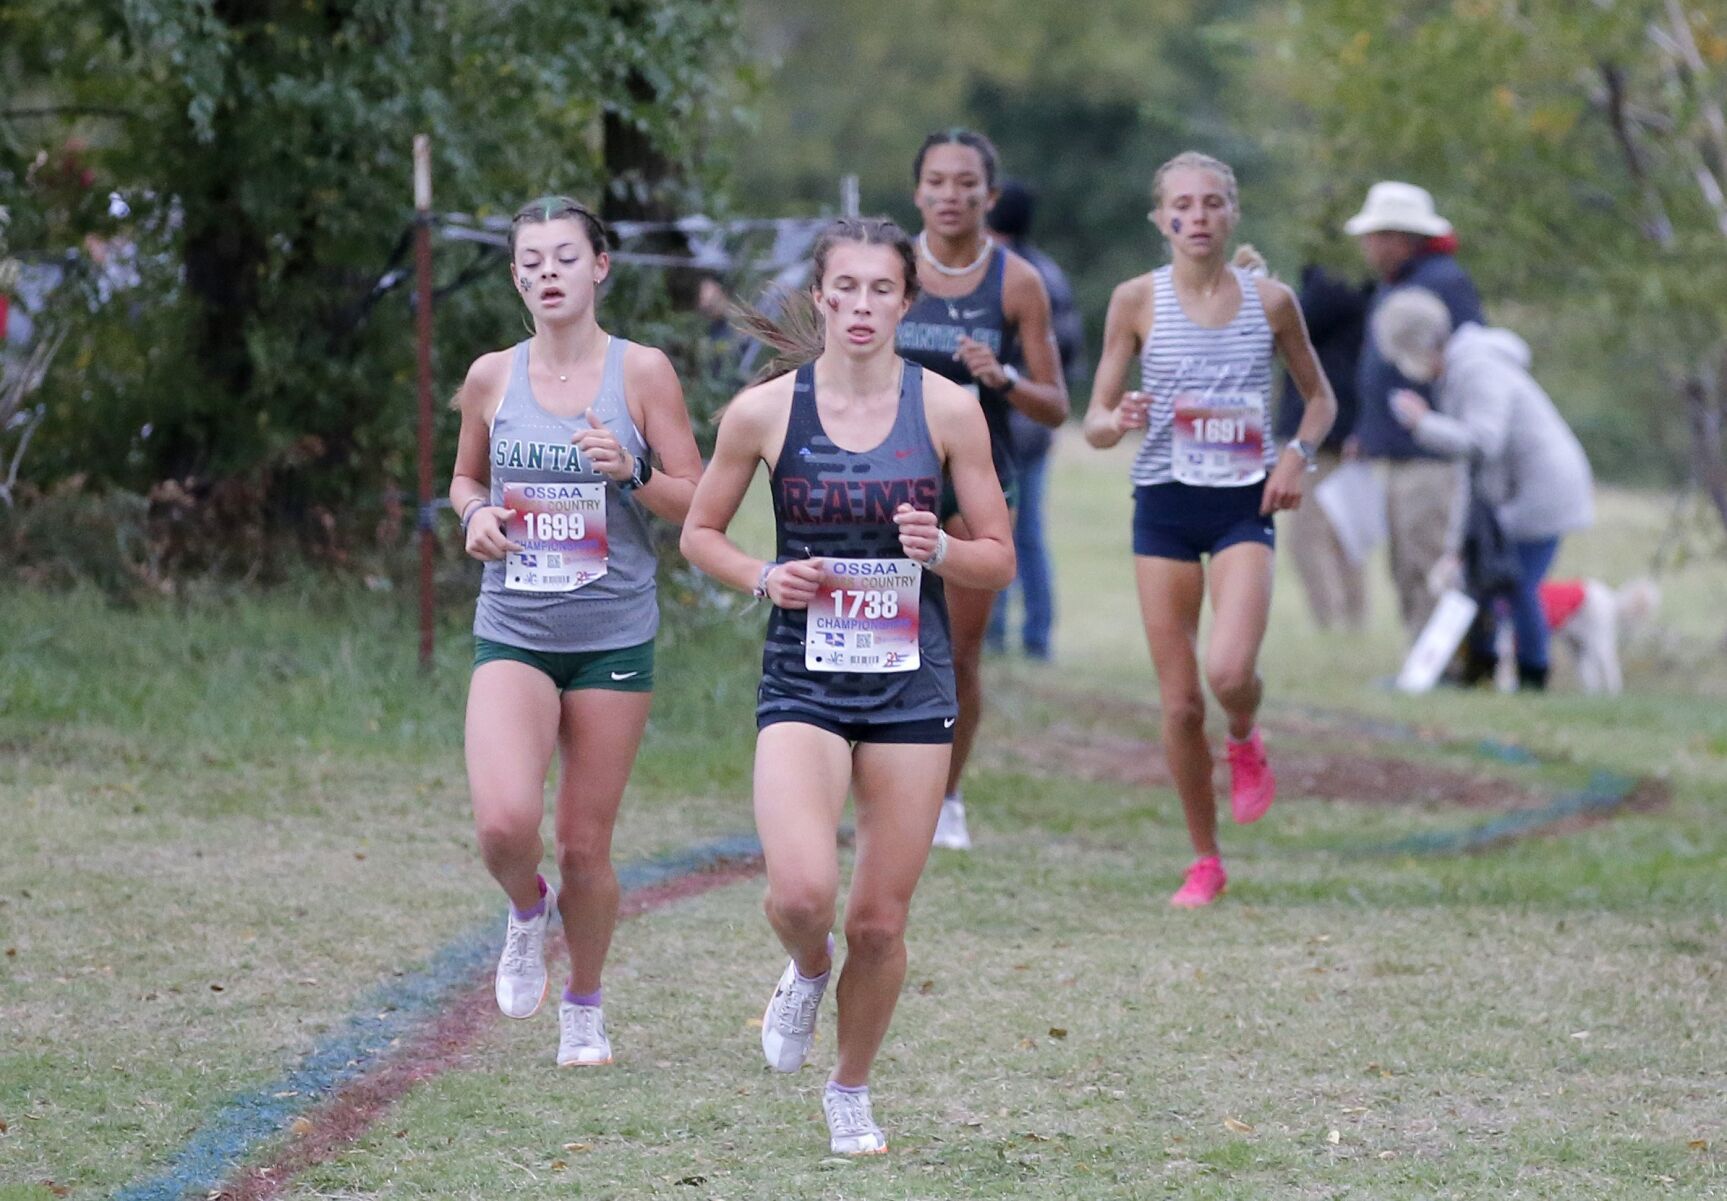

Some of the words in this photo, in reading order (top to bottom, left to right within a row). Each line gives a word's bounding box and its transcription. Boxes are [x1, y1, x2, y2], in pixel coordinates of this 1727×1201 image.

[1191, 418, 1247, 443] 1691
[496, 440, 582, 473] SANTA
[524, 486, 583, 499] OSSAA
[782, 477, 938, 525] RAMS
[547, 499, 600, 512] COUNTRY
[524, 512, 585, 541] 1699
[833, 562, 898, 576] OSSAA
[861, 575, 916, 589] COUNTRY
[830, 589, 899, 619] 1738
